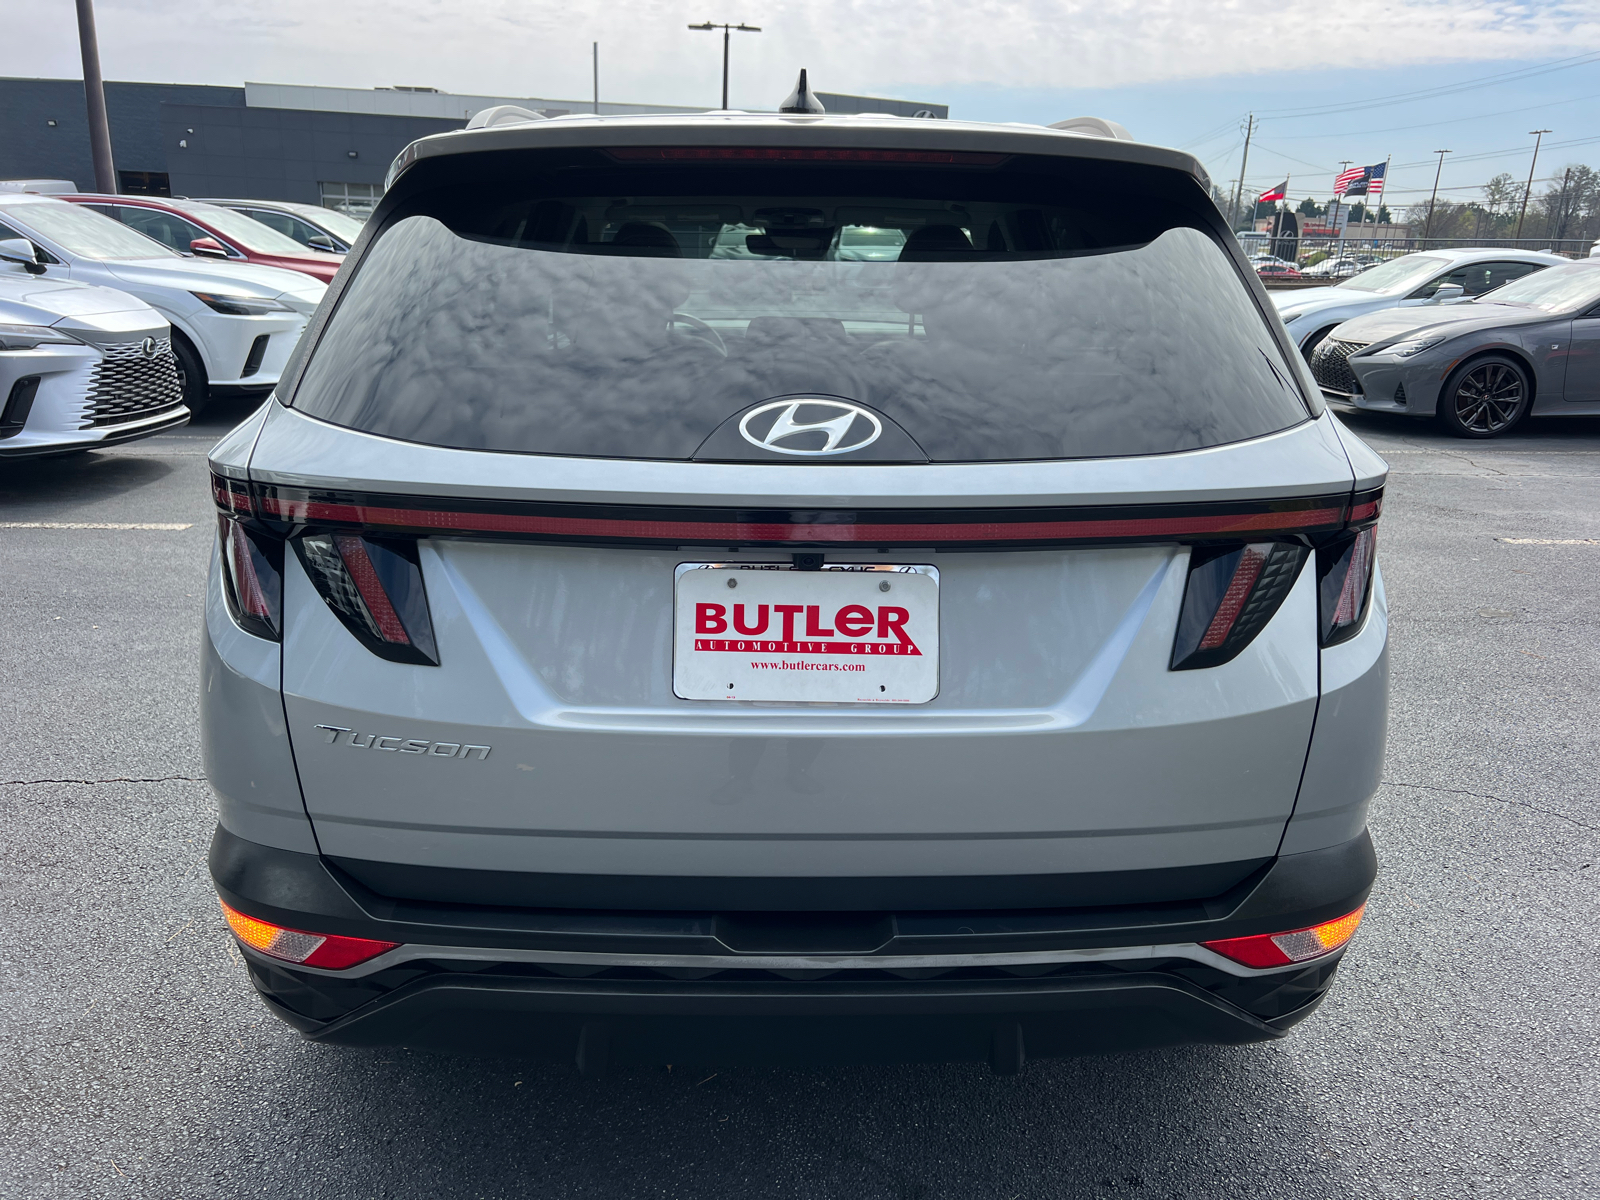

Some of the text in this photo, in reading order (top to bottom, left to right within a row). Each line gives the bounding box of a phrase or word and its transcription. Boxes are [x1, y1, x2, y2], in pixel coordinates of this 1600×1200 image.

[695, 641, 915, 655] AUTOMOTIVE GROUP
[750, 660, 866, 672] www.butlercars.com
